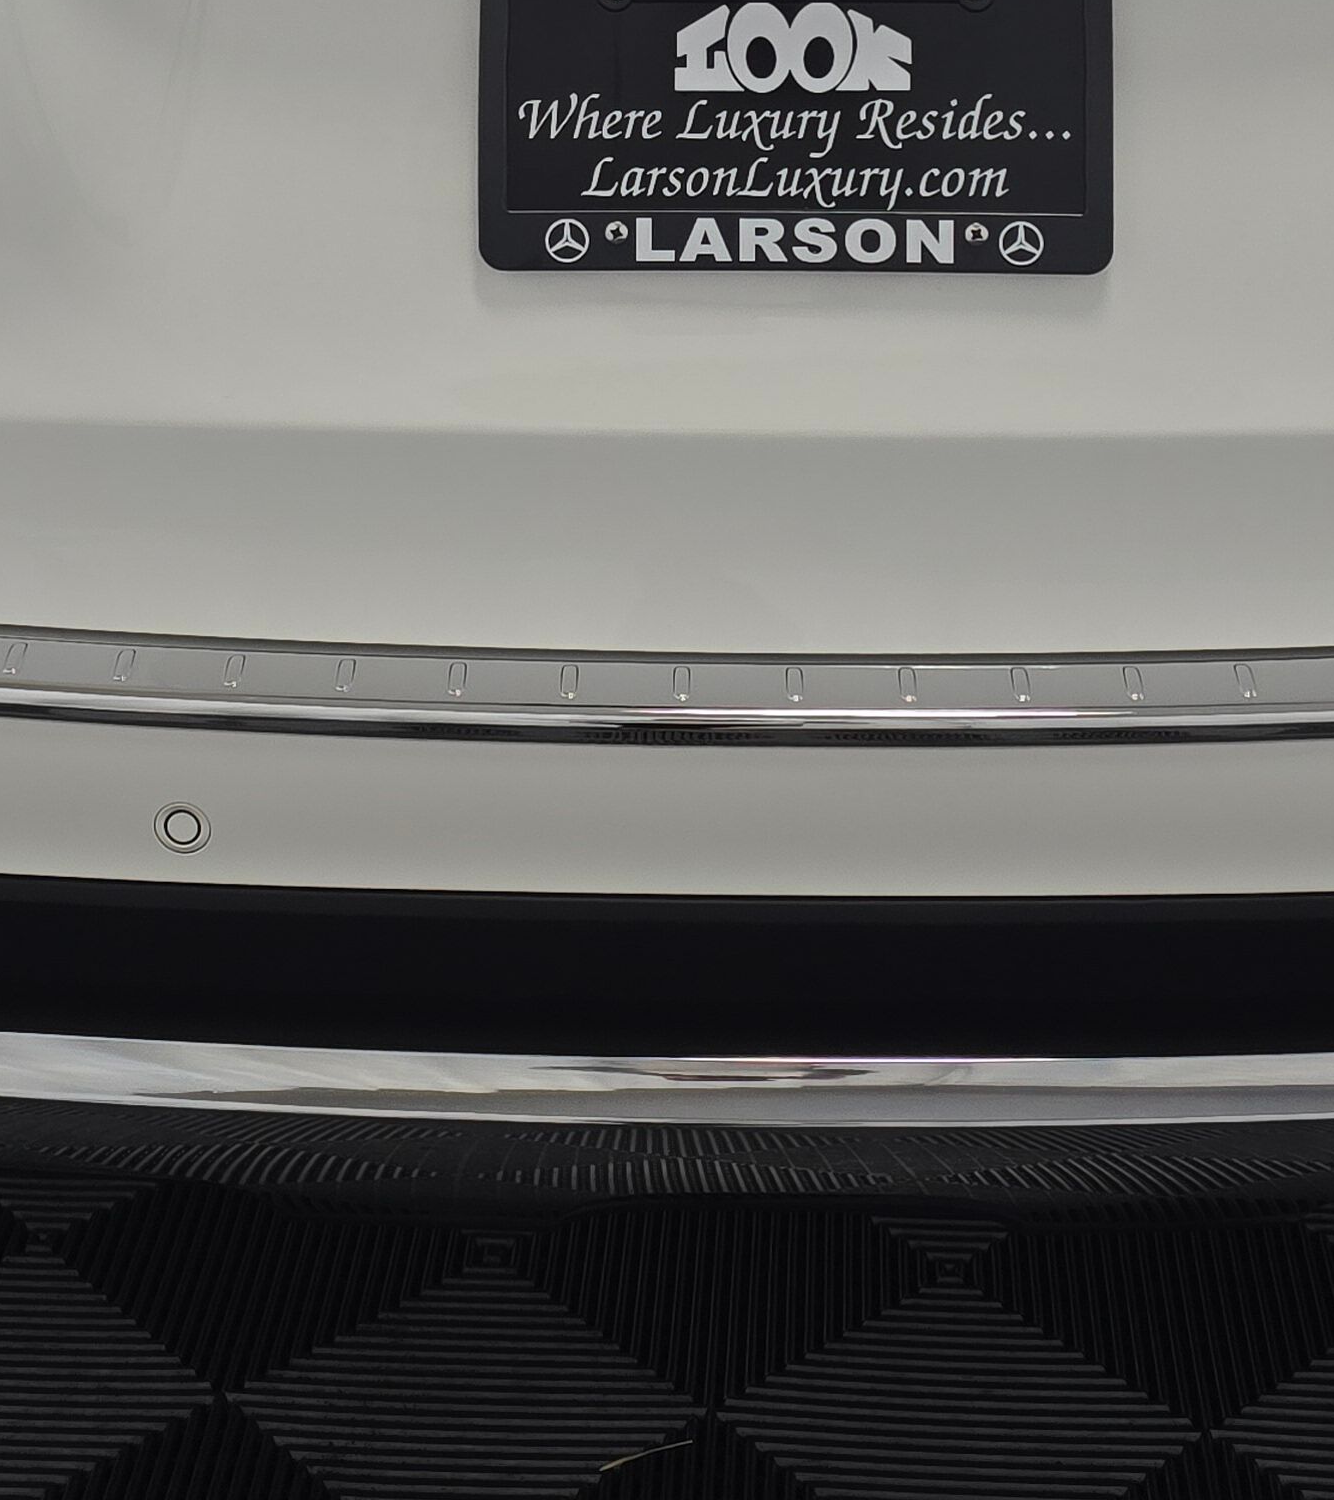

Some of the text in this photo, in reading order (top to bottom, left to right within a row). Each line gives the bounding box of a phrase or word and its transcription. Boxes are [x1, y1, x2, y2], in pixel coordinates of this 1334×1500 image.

[518, 92, 1072, 159] Where Luxury Resides...
[580, 156, 1009, 211] LarsonLuxury.com
[635, 217, 955, 264] LARSON
